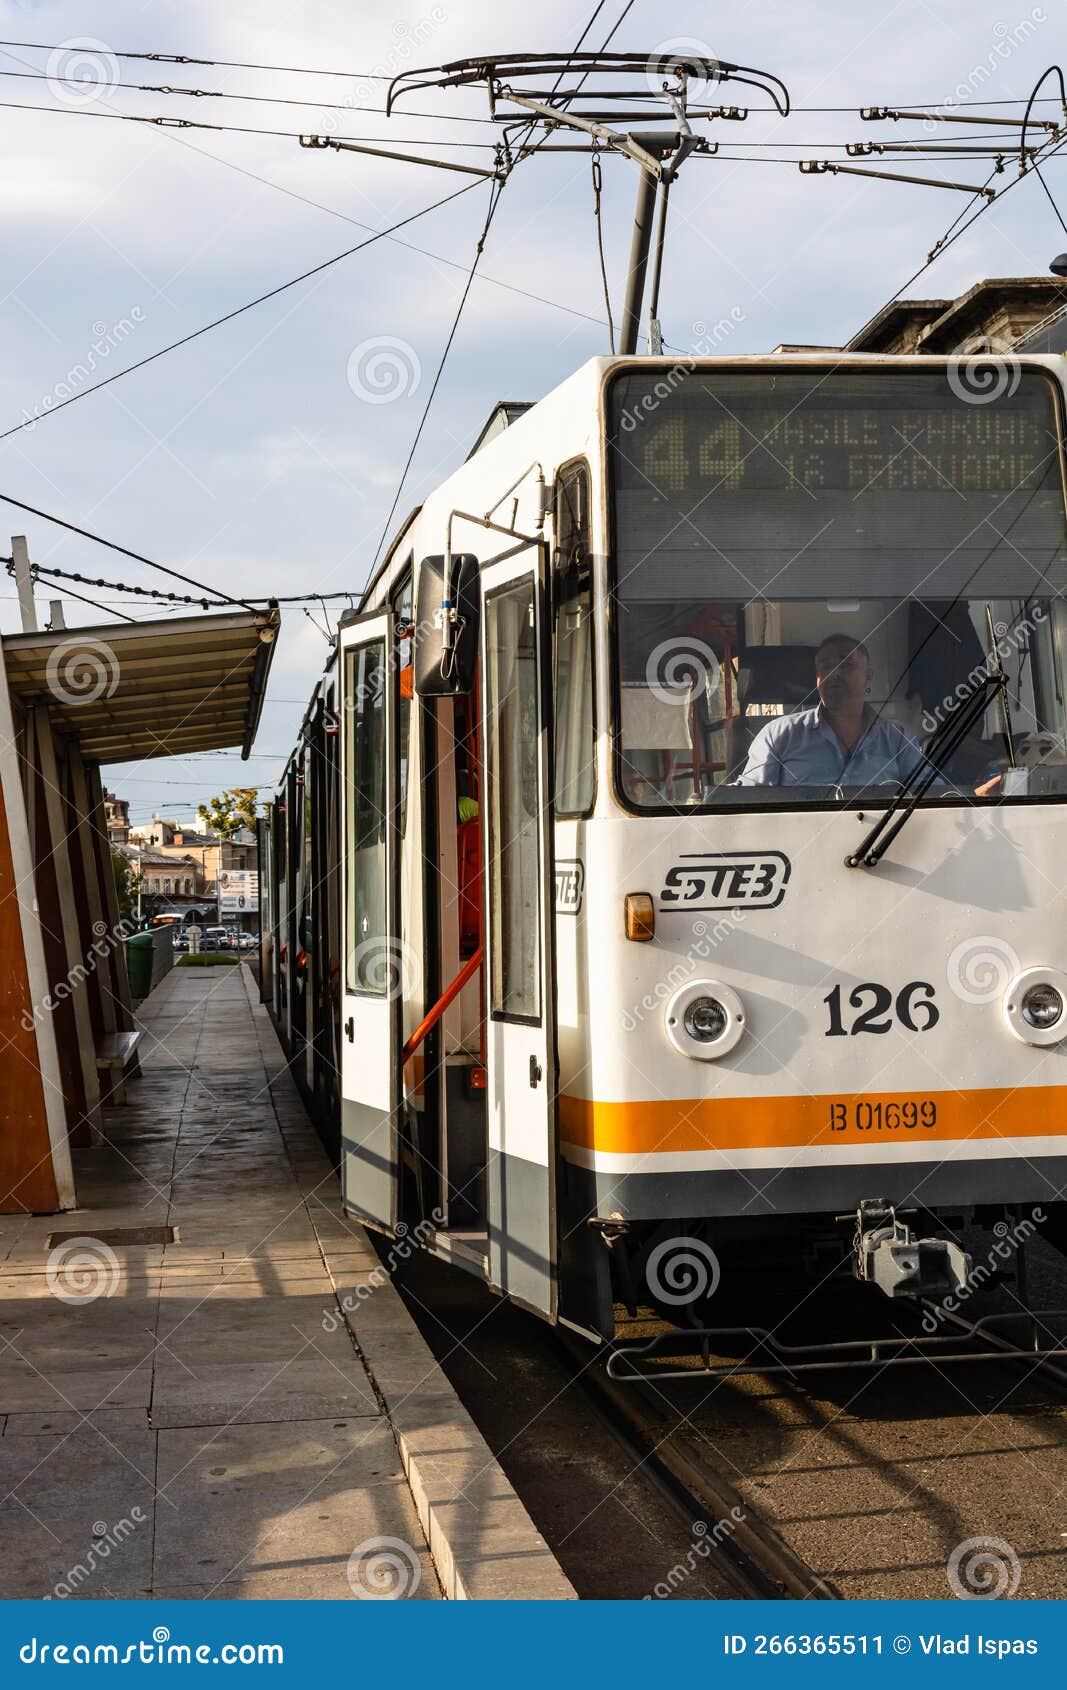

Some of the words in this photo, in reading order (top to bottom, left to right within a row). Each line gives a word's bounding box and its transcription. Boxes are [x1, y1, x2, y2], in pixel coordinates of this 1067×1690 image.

[644, 415, 745, 491] 44
[823, 981, 940, 1037] 126
[830, 1103, 847, 1131] B
[856, 1101, 937, 1130] 01699
